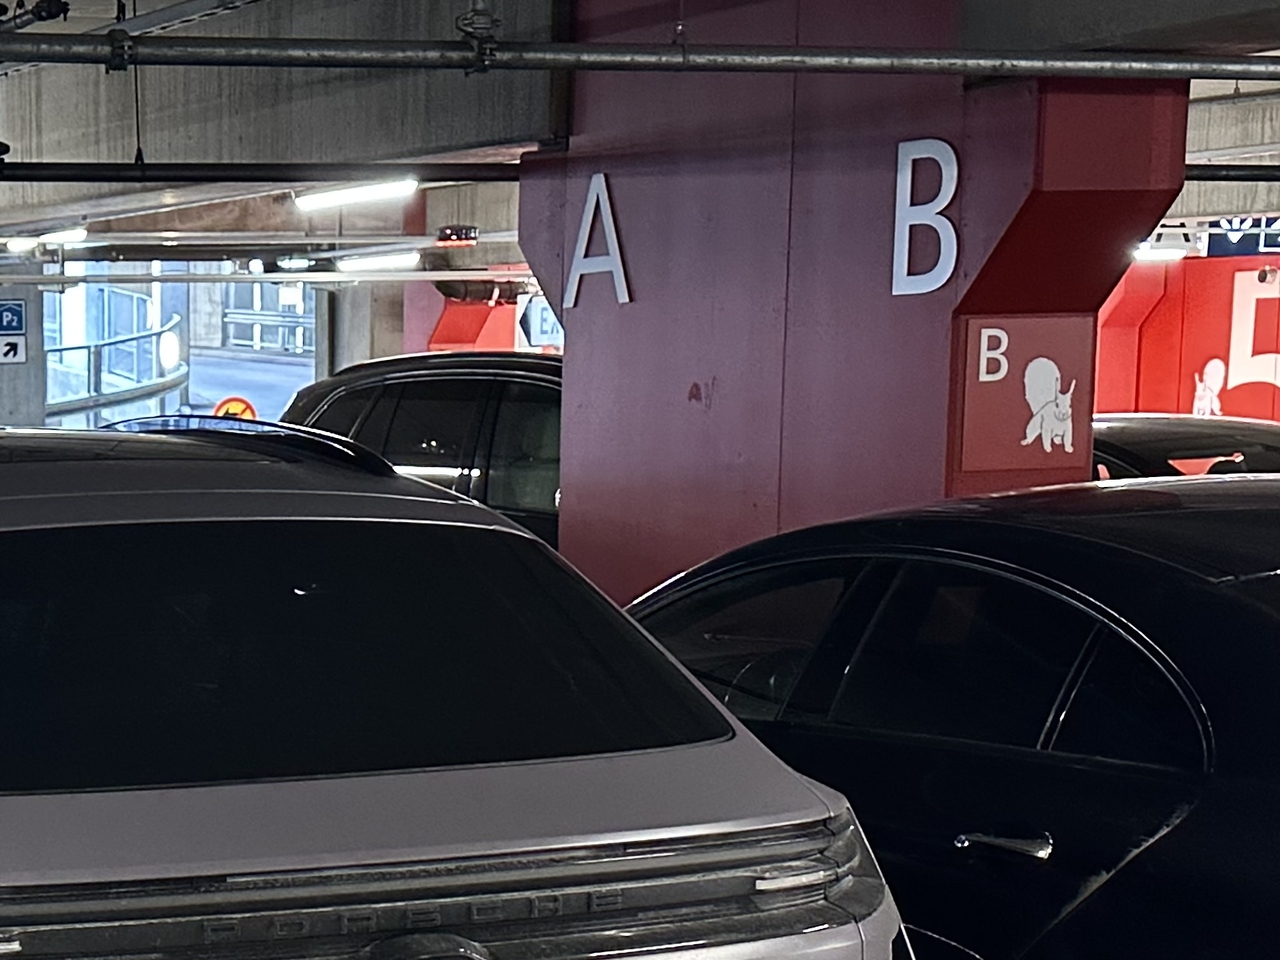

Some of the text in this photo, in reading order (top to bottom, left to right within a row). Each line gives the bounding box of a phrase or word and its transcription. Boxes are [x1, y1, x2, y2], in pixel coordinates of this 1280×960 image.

[563, 173, 630, 309] A
[892, 138, 959, 296] B
[978, 328, 1010, 382] B
[204, 889, 623, 943] PORSCHE
